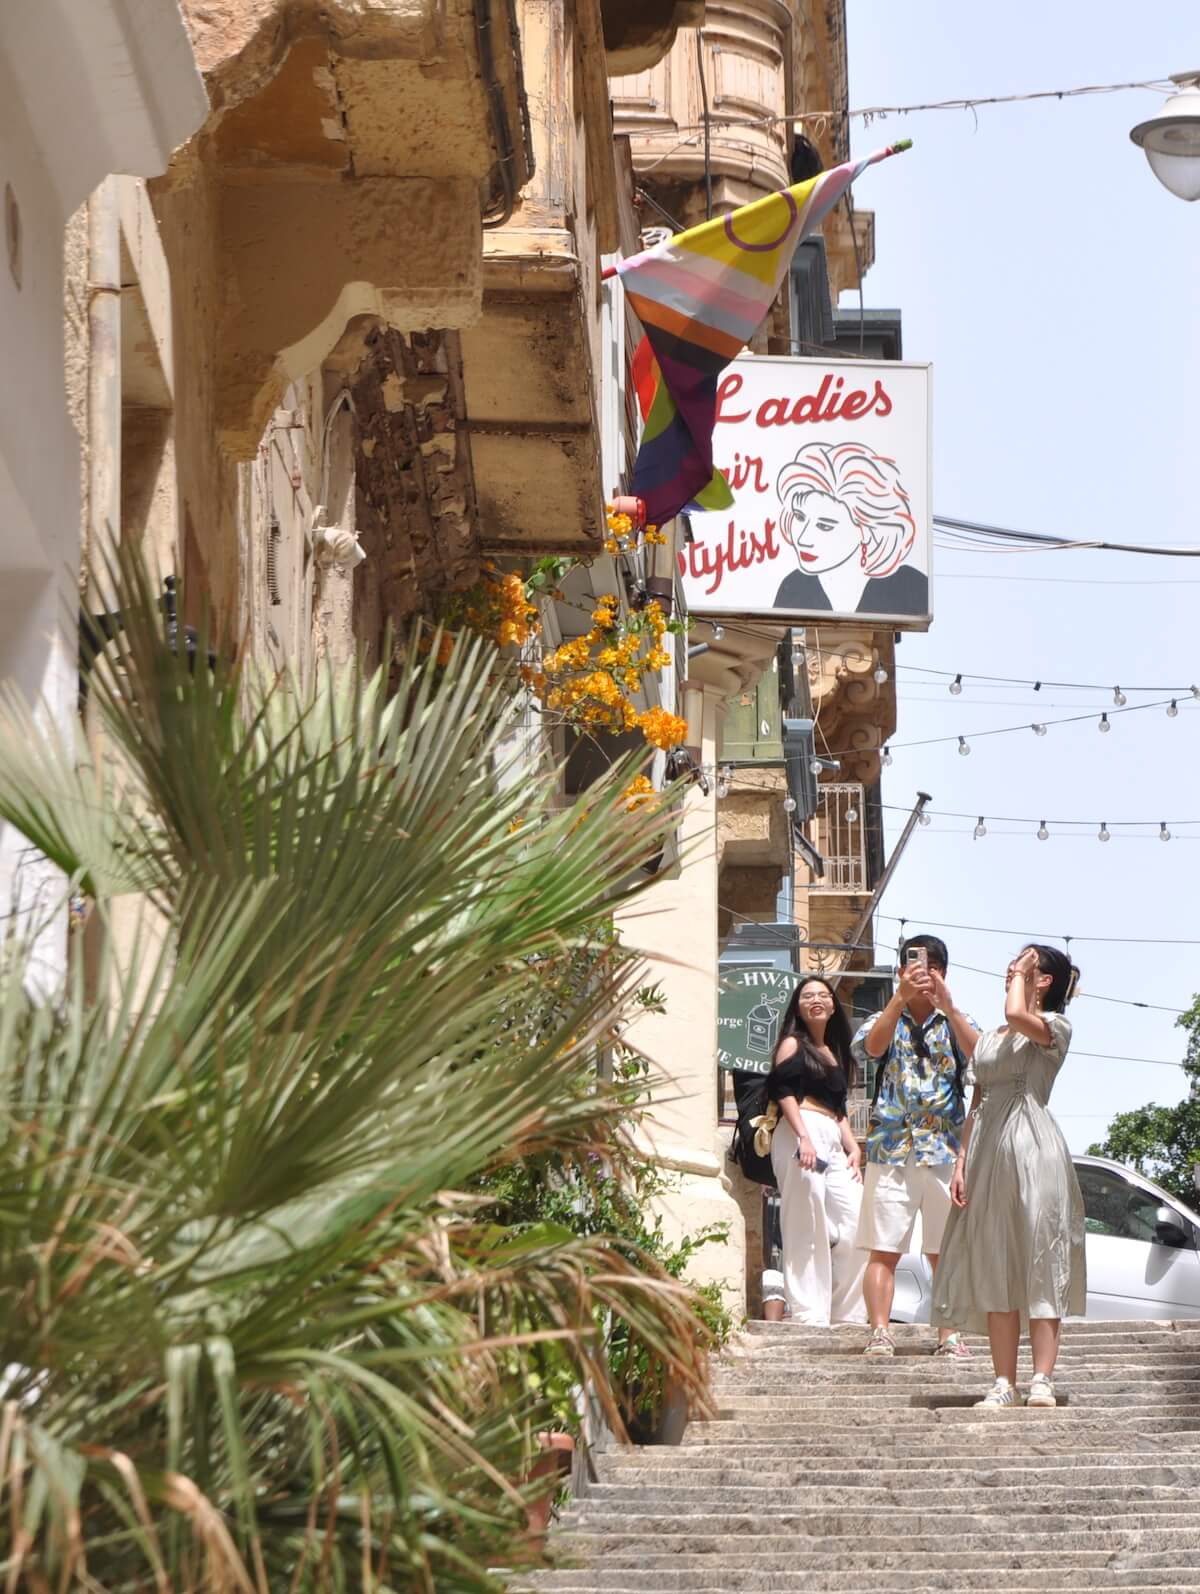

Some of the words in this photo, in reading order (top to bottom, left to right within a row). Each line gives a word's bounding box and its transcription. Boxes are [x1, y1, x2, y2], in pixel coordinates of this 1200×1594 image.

[715, 373, 892, 428] Ladies
[719, 452, 769, 493] ir
[717, 1017, 743, 1029] orge
[733, 1057, 771, 1074] SPIC
